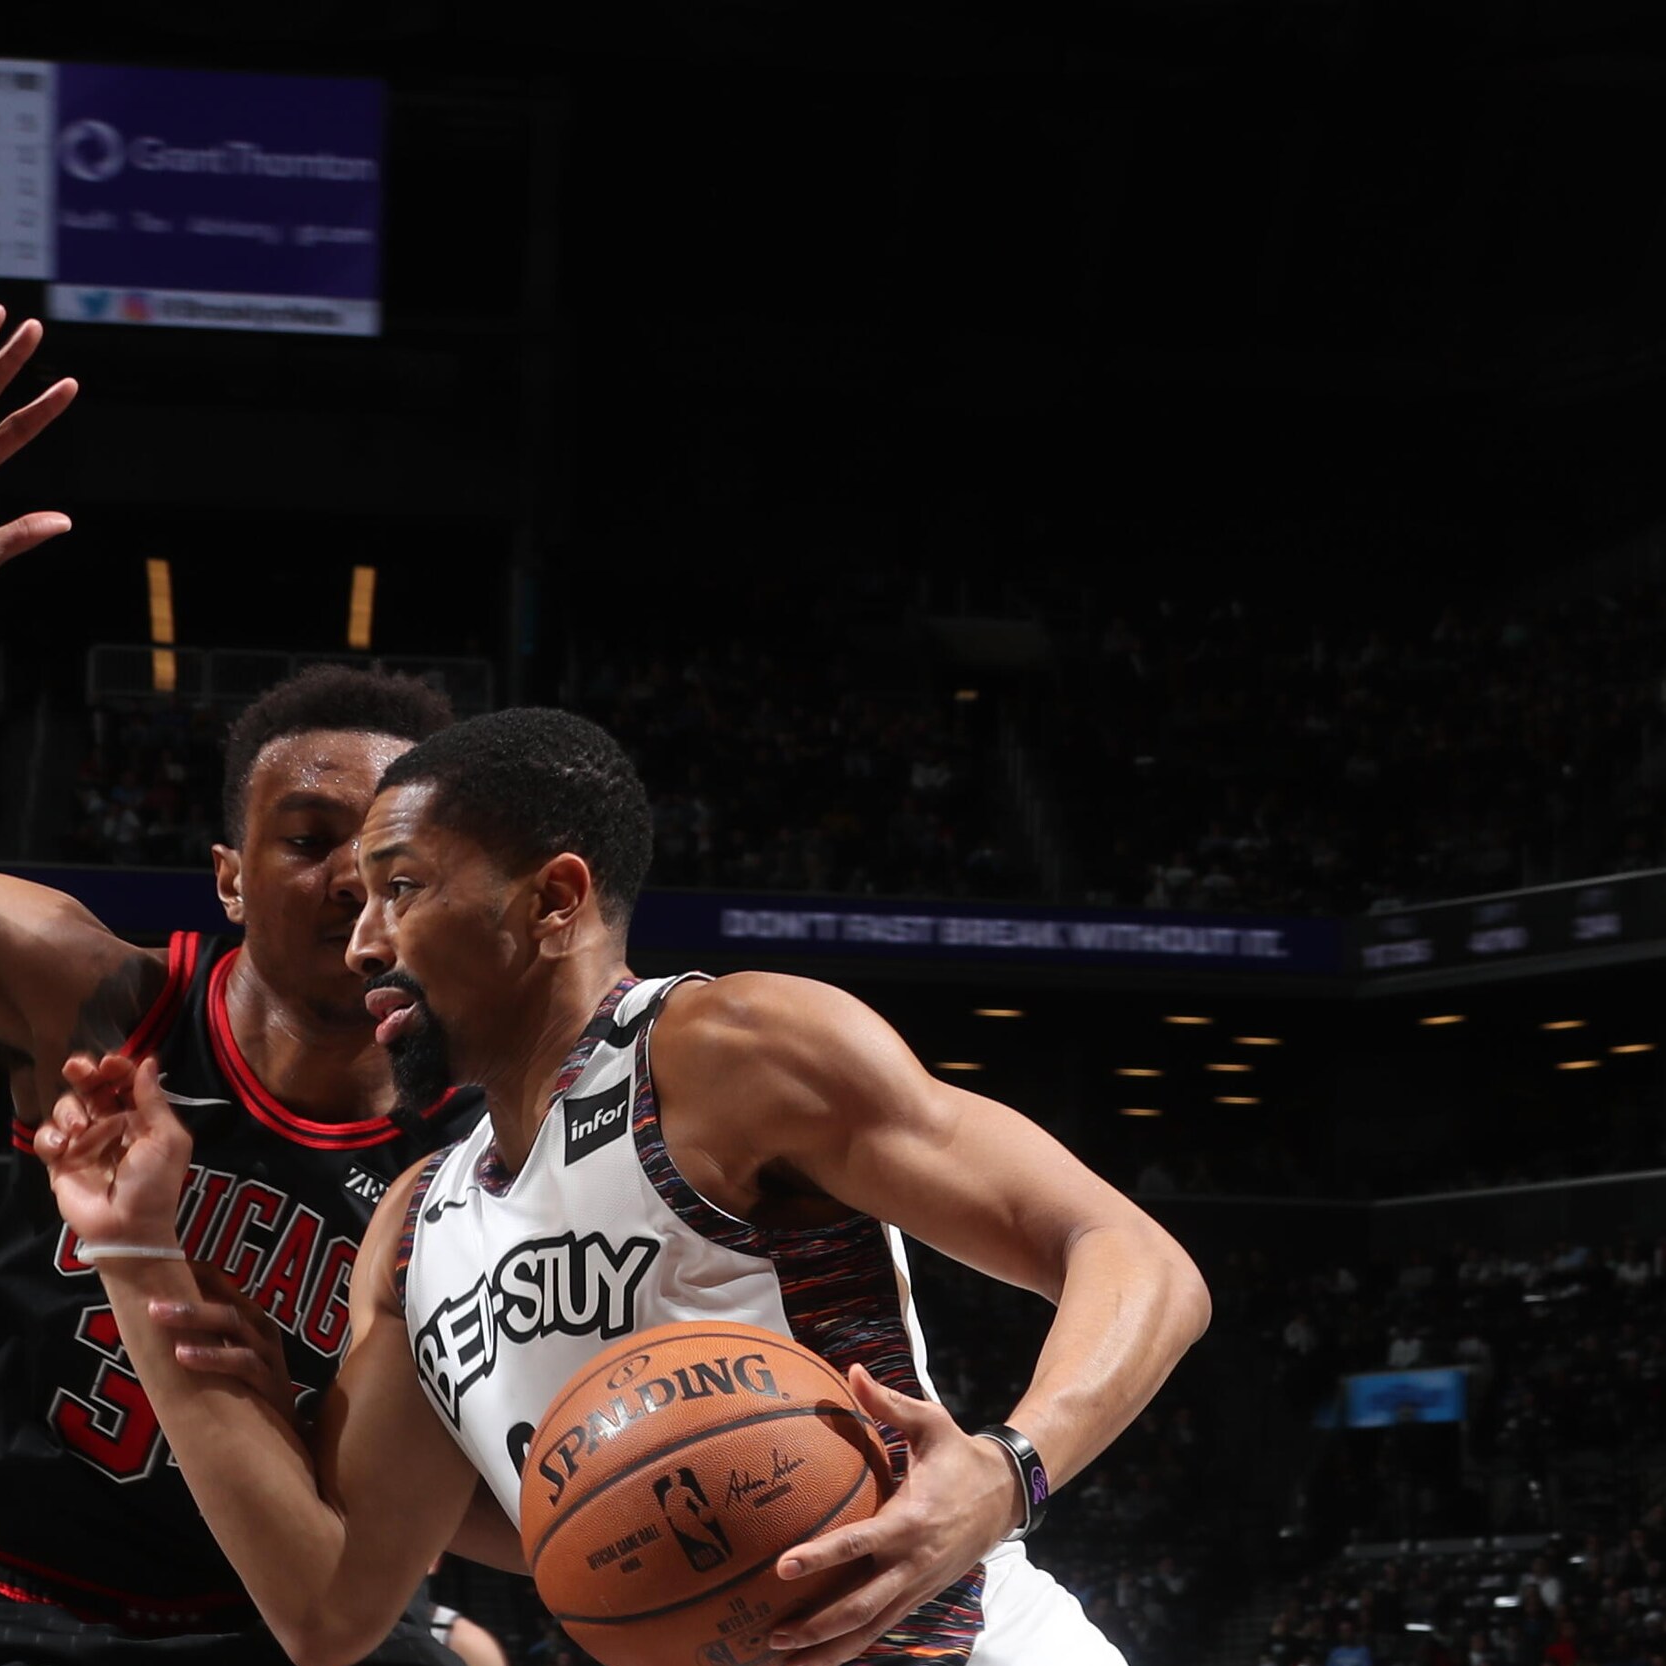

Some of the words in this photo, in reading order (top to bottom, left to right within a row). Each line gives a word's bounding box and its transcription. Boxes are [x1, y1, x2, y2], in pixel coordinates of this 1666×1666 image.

[841, 913, 934, 944] FAST
[937, 917, 1067, 949] BREAK
[1069, 922, 1235, 956] WITHOUT
[571, 1100, 628, 1142] infor
[539, 1353, 780, 1507] SPALDING
